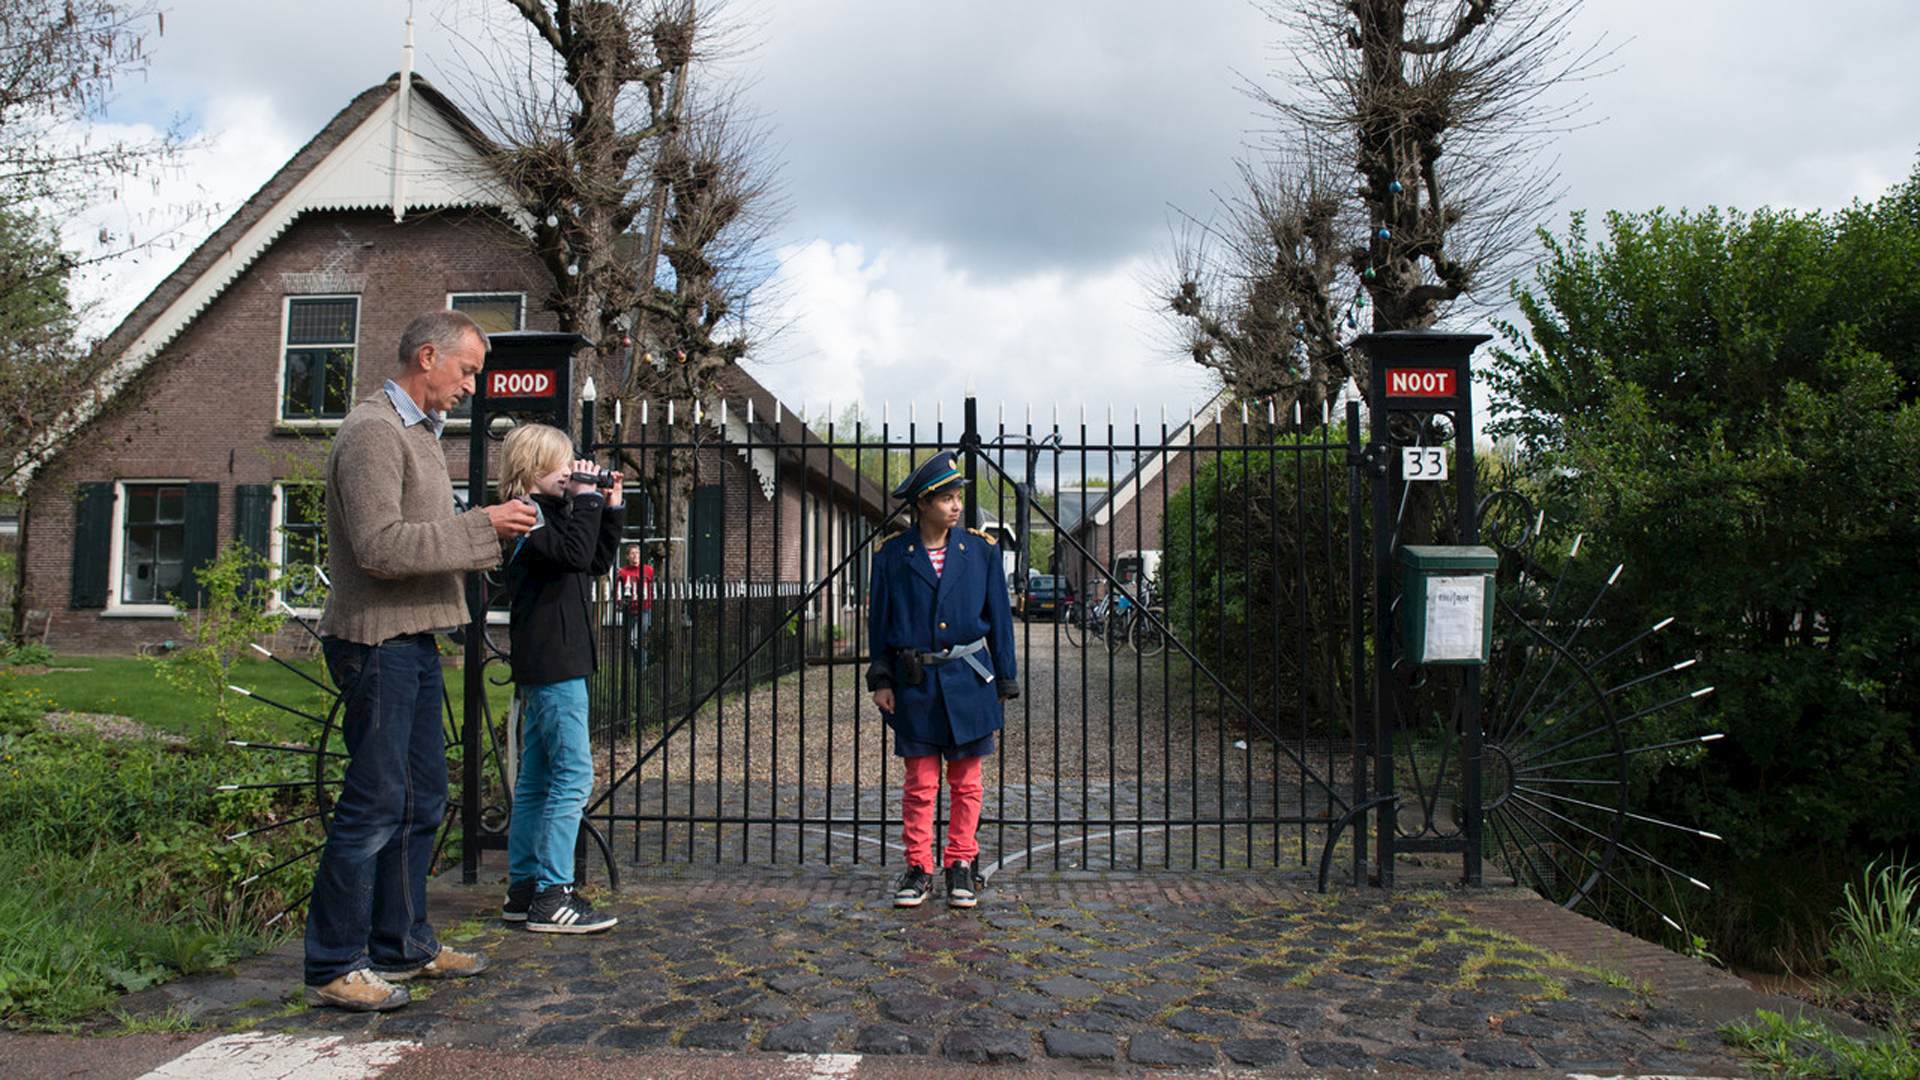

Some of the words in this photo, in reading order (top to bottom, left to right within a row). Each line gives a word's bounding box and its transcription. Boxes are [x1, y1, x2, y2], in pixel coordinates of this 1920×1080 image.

[493, 373, 549, 393] ROOD
[1393, 372, 1449, 392] NOOT
[1408, 451, 1443, 476] 33
